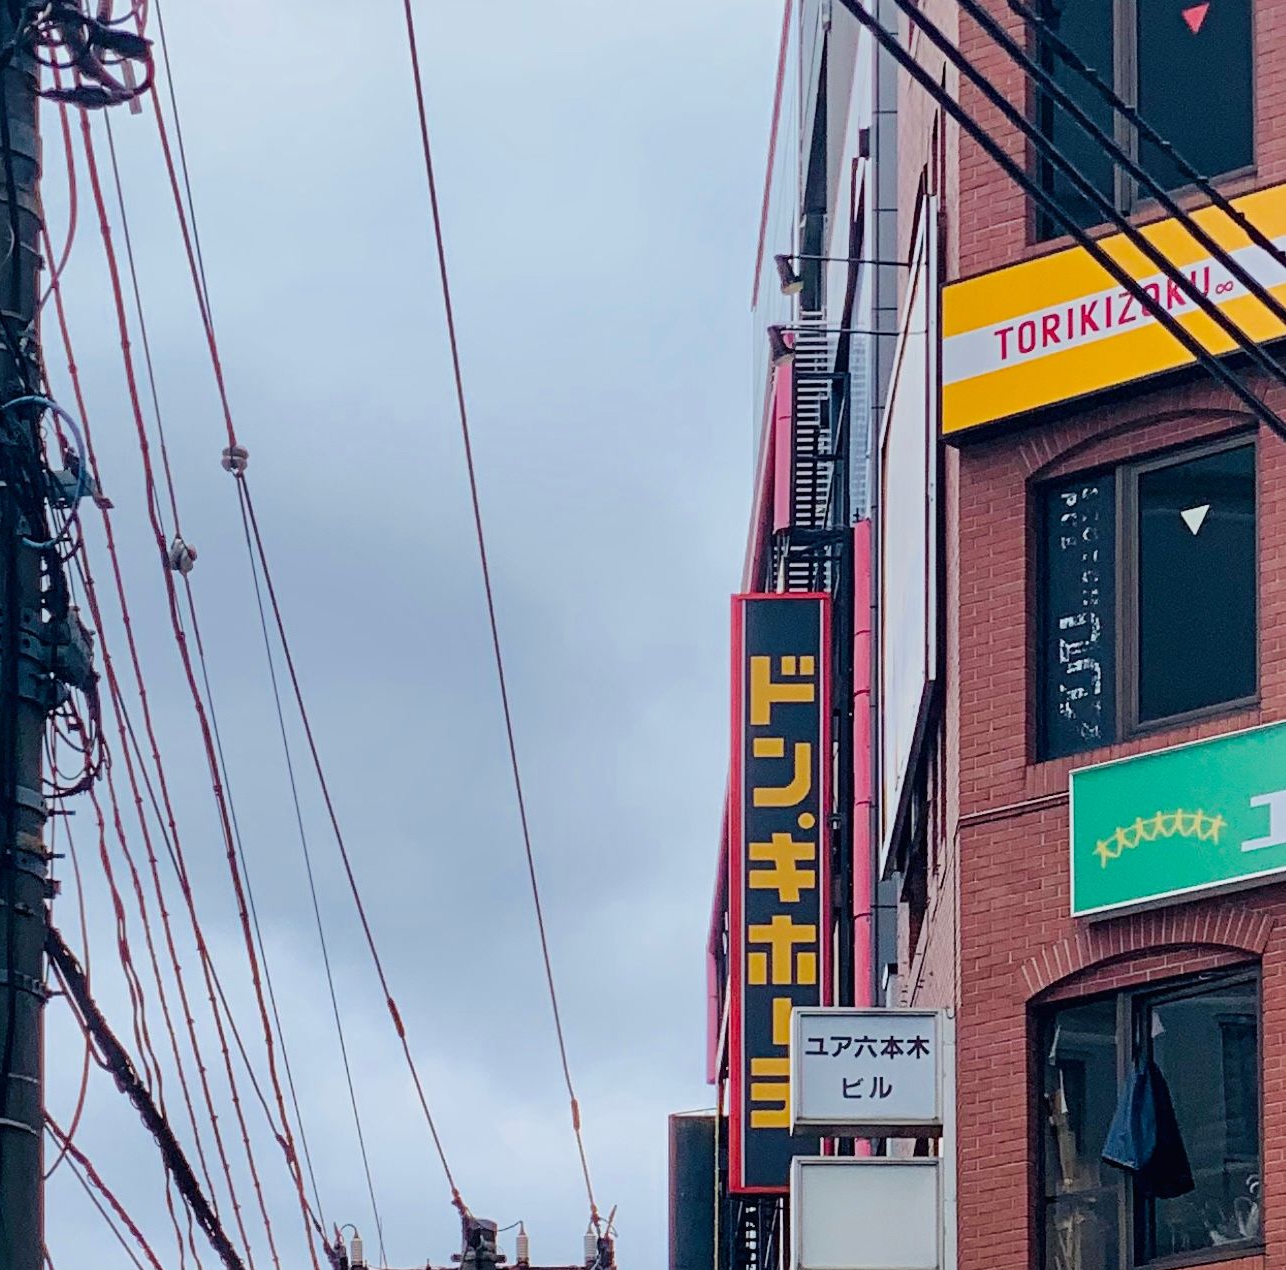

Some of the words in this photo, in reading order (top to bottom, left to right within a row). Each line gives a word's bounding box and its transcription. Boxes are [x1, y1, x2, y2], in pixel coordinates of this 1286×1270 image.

[804, 1034, 930, 1060] ユア六本木
[841, 1075, 893, 1100] ビル
